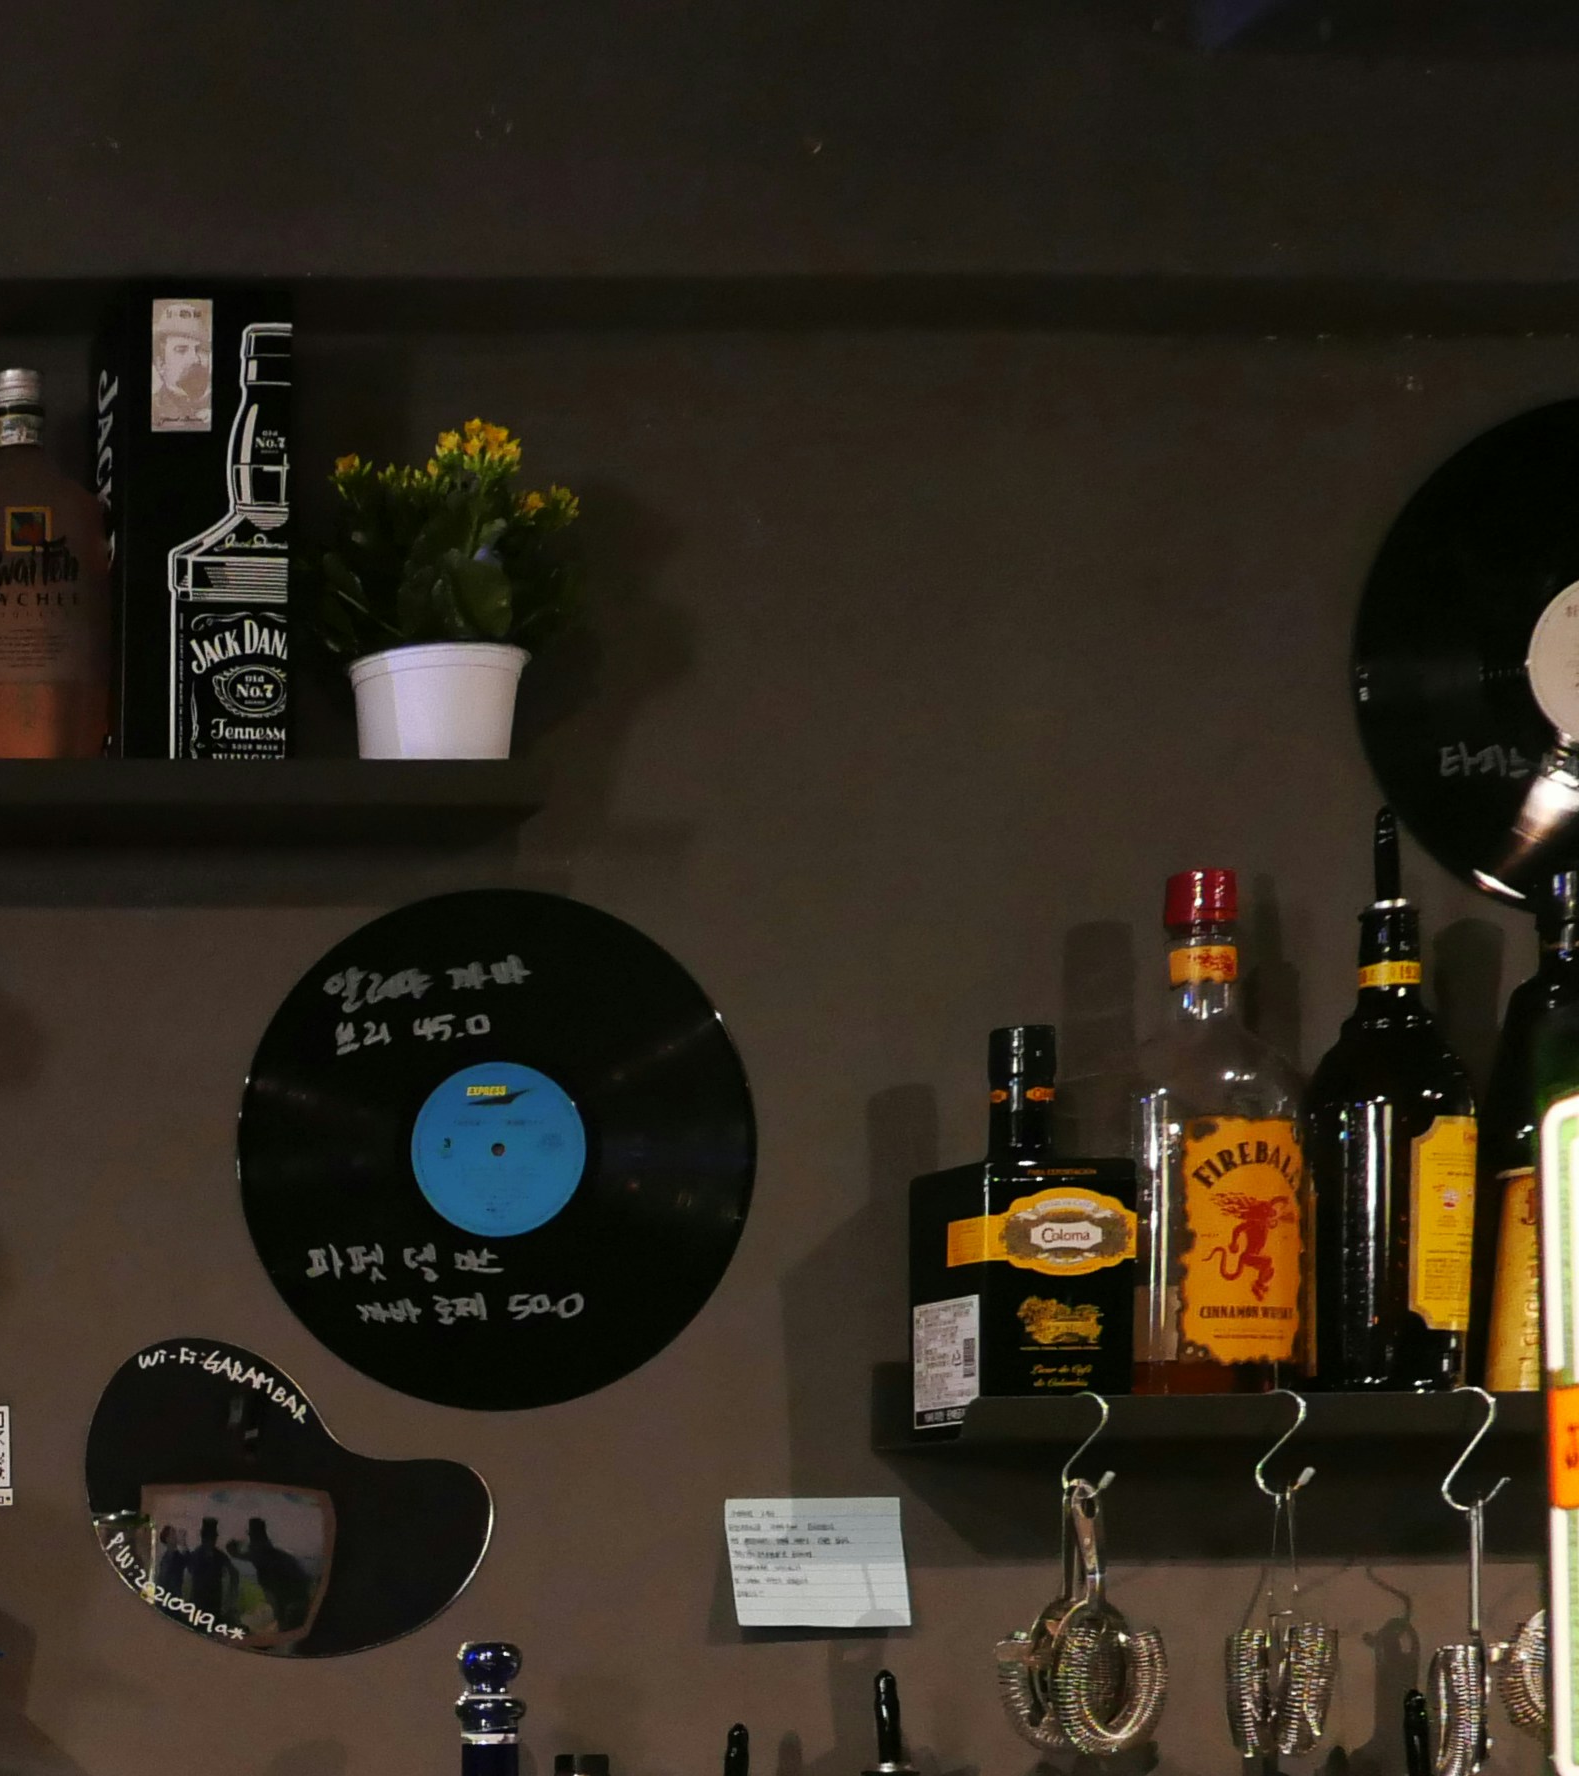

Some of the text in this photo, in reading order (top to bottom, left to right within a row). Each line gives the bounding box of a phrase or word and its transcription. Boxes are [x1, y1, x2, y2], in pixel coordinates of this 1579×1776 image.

[190, 629, 241, 675] JACK
[466, 1085, 507, 1097] EXPRESS
[1040, 1226, 1091, 1244] Coloma
[1200, 1305, 1257, 1320] CINNAMON
